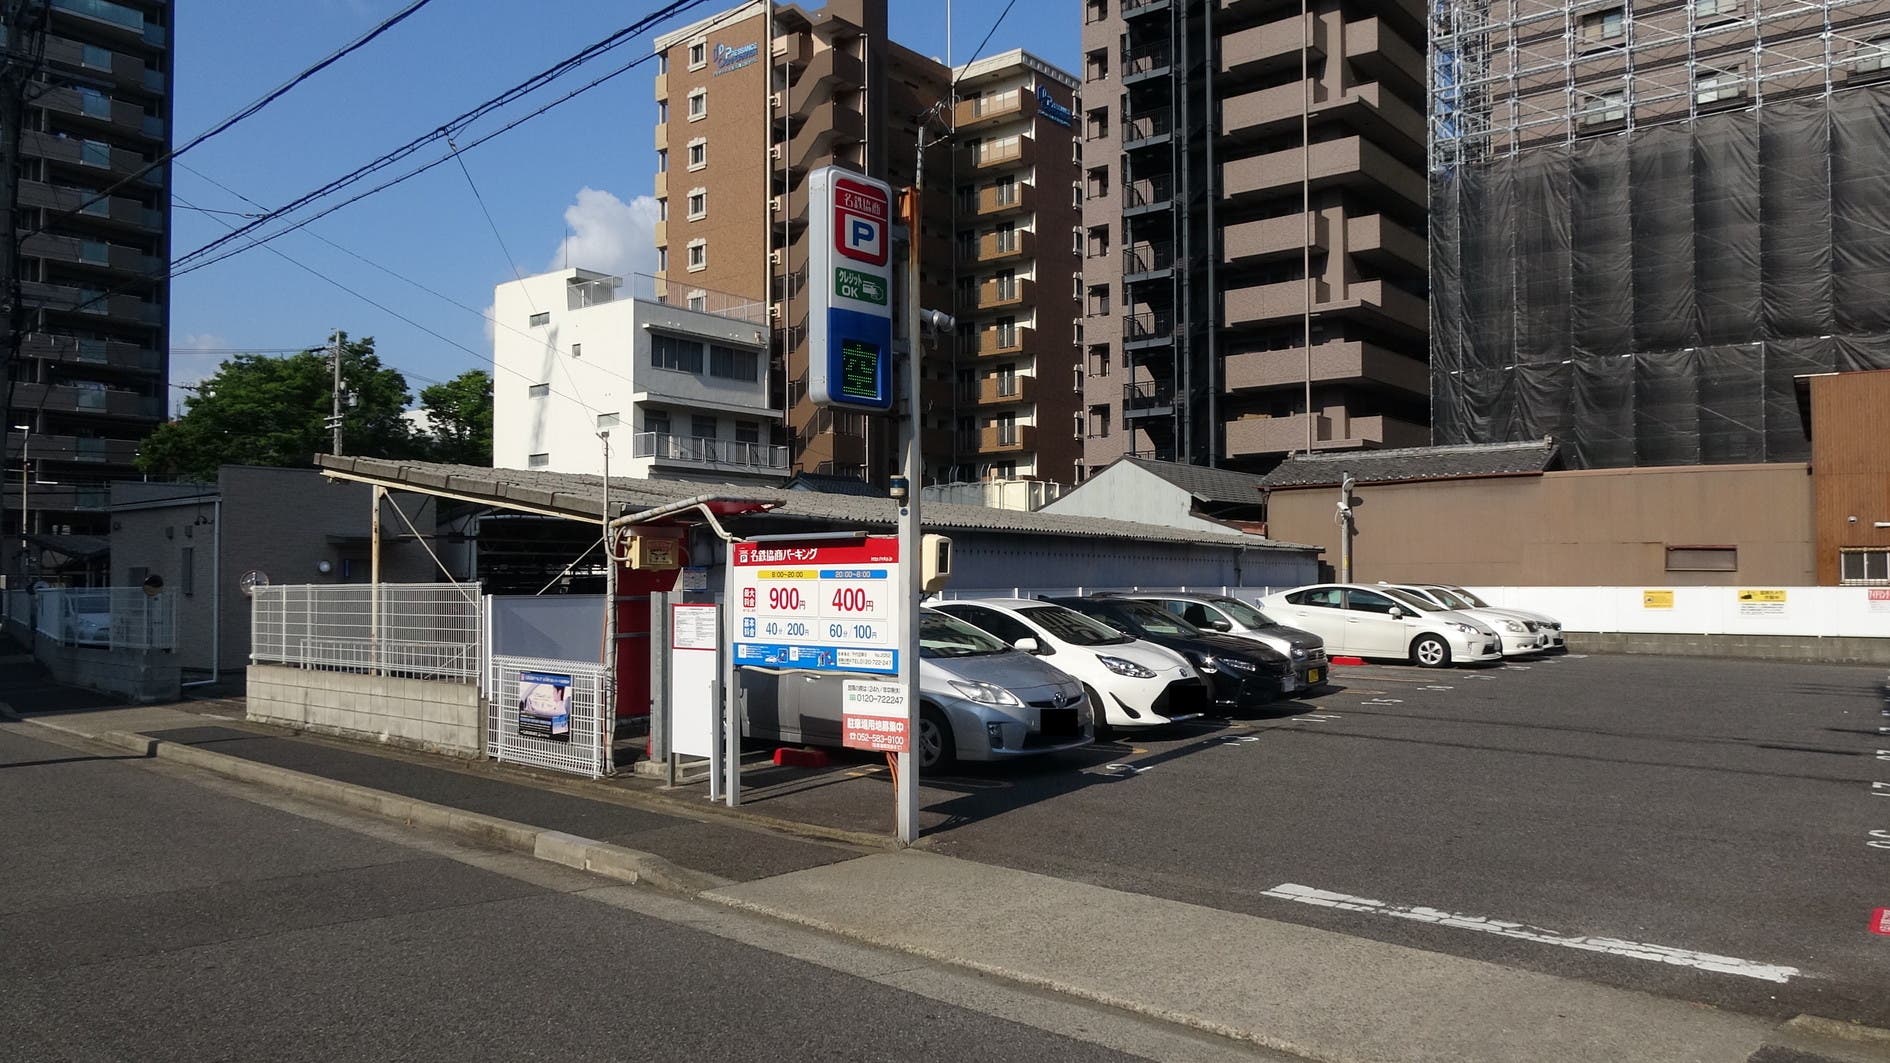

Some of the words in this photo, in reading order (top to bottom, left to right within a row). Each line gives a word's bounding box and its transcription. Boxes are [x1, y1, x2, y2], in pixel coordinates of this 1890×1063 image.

[844, 193, 881, 216] 名鉄協商
[852, 220, 875, 247] P
[839, 270, 863, 286] クレジット
[842, 285, 858, 298] OK
[843, 344, 877, 397] 空
[750, 548, 818, 562] 名鉄協商パーキング
[769, 587, 806, 611] 900円
[832, 588, 874, 612] 400円
[857, 694, 904, 704] 0120-722247
